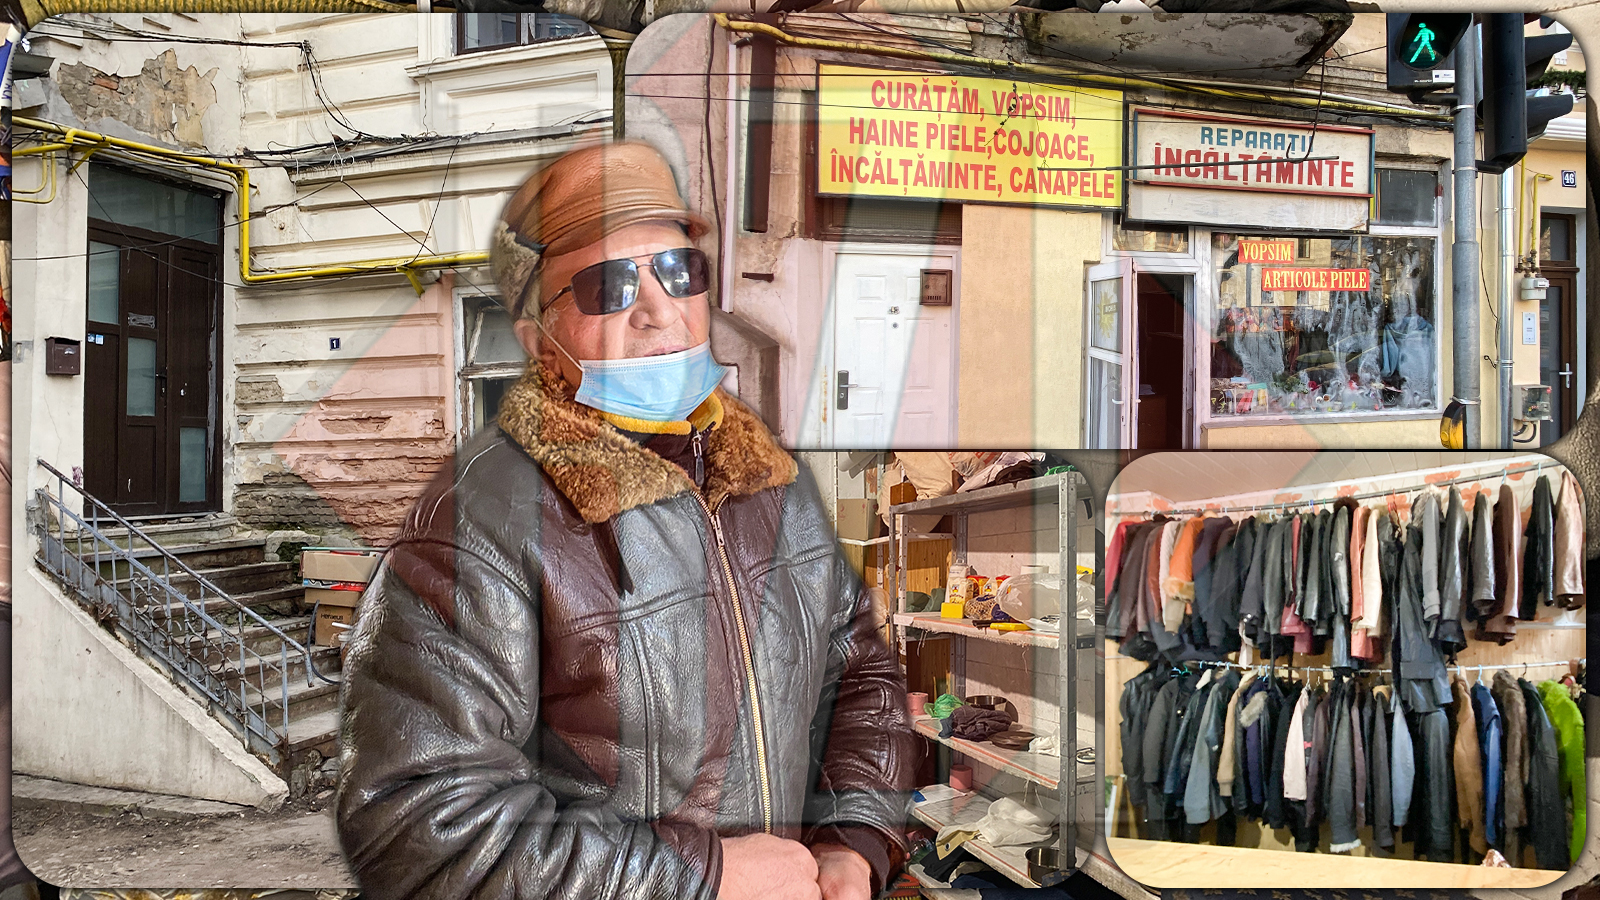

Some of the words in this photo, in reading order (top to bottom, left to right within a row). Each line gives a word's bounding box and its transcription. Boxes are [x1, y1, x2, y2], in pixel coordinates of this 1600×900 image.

[992, 90, 1076, 130] VOPSIM,
[849, 116, 918, 148] HAINE
[1009, 167, 1115, 199] CANAPELE
[1564, 172, 1575, 185] 46
[1242, 242, 1292, 262] VOPSIM
[1263, 271, 1327, 289] ARTICOLE
[1330, 271, 1368, 290] PIELE
